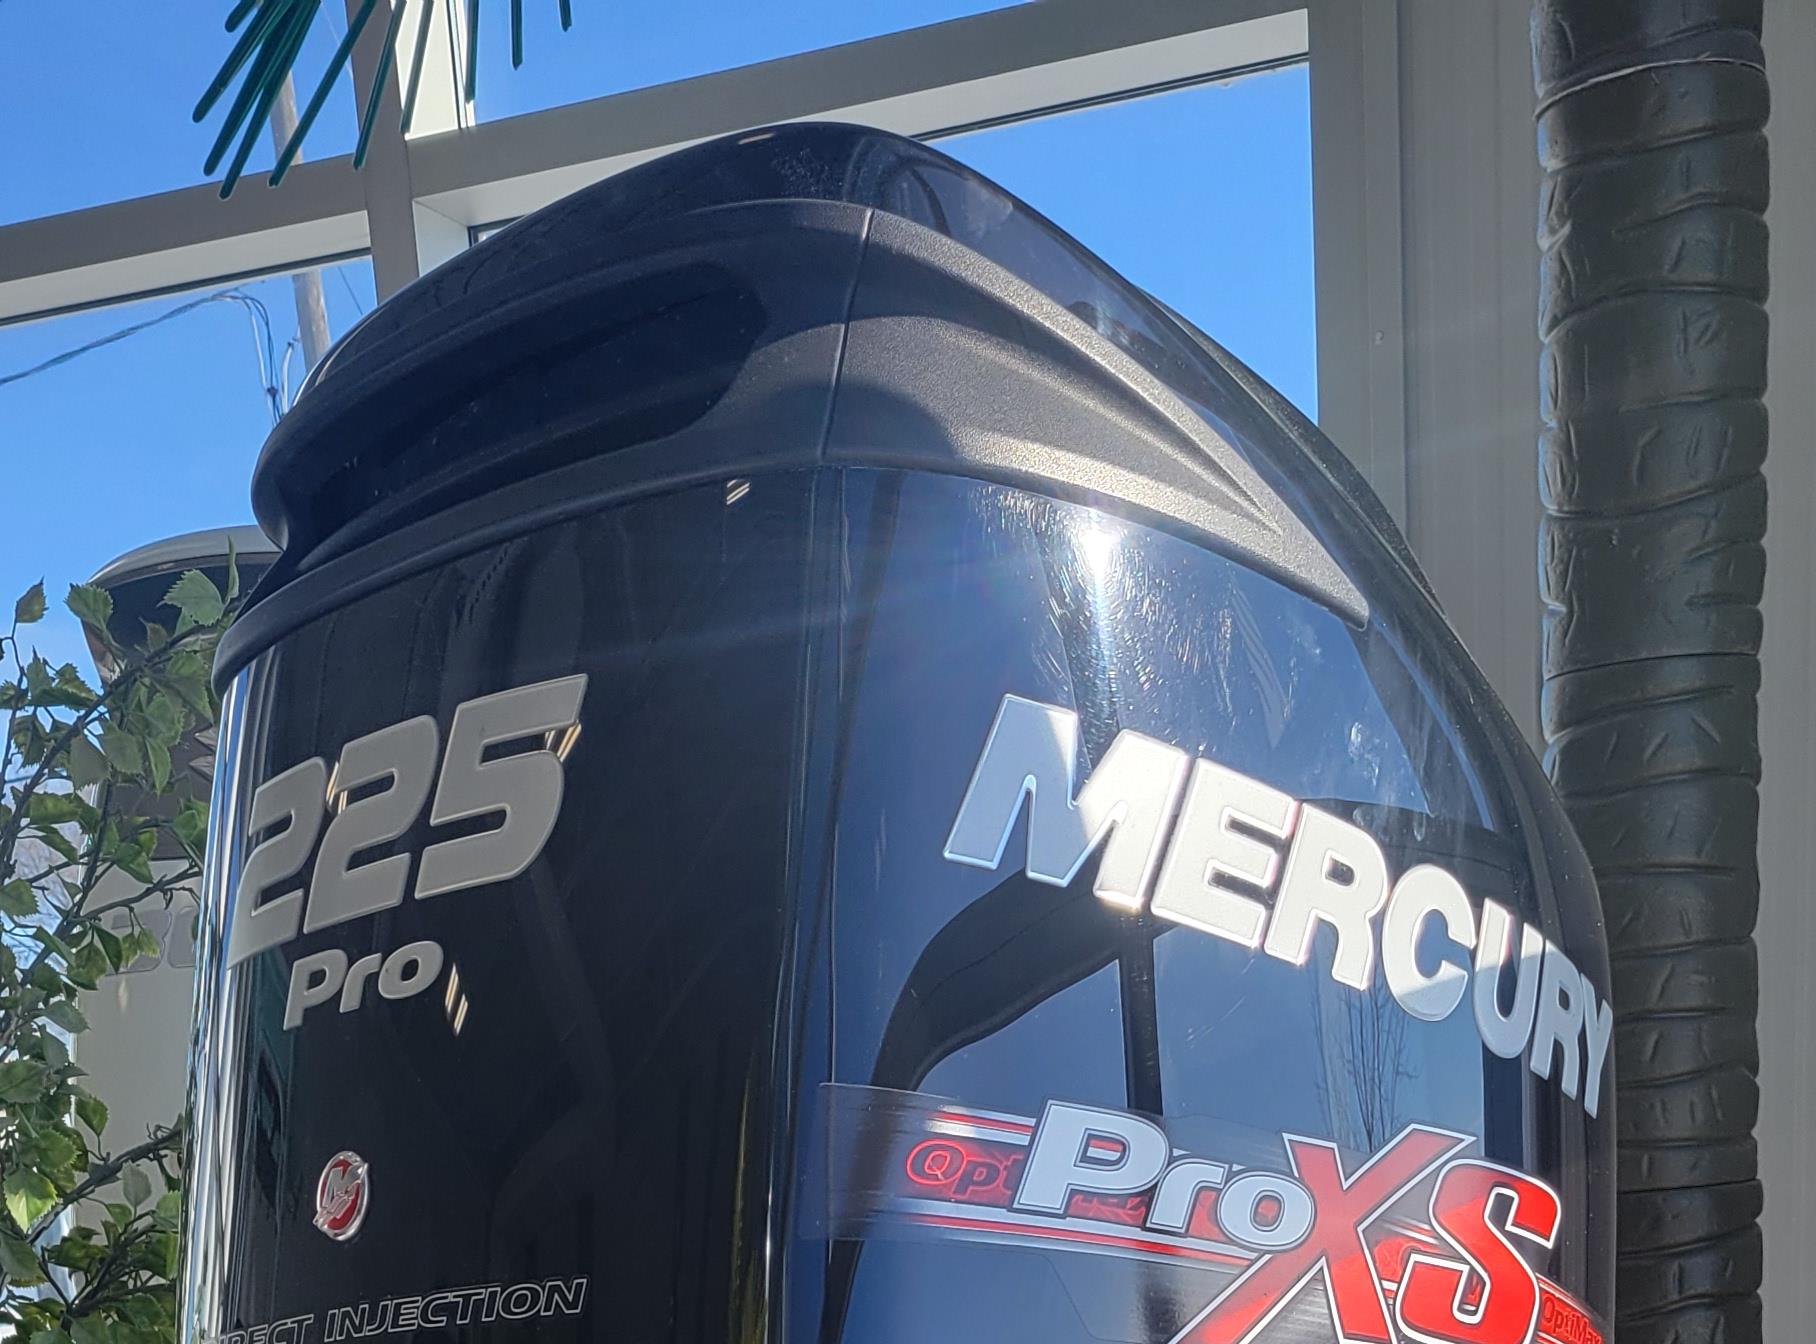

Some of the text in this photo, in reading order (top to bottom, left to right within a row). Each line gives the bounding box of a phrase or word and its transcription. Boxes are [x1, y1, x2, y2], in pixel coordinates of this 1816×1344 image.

[227, 673, 589, 971] 225
[943, 694, 1614, 1119] MERCURY
[282, 939, 445, 1031] Pro
[323, 1276, 589, 1344] INJECTION
